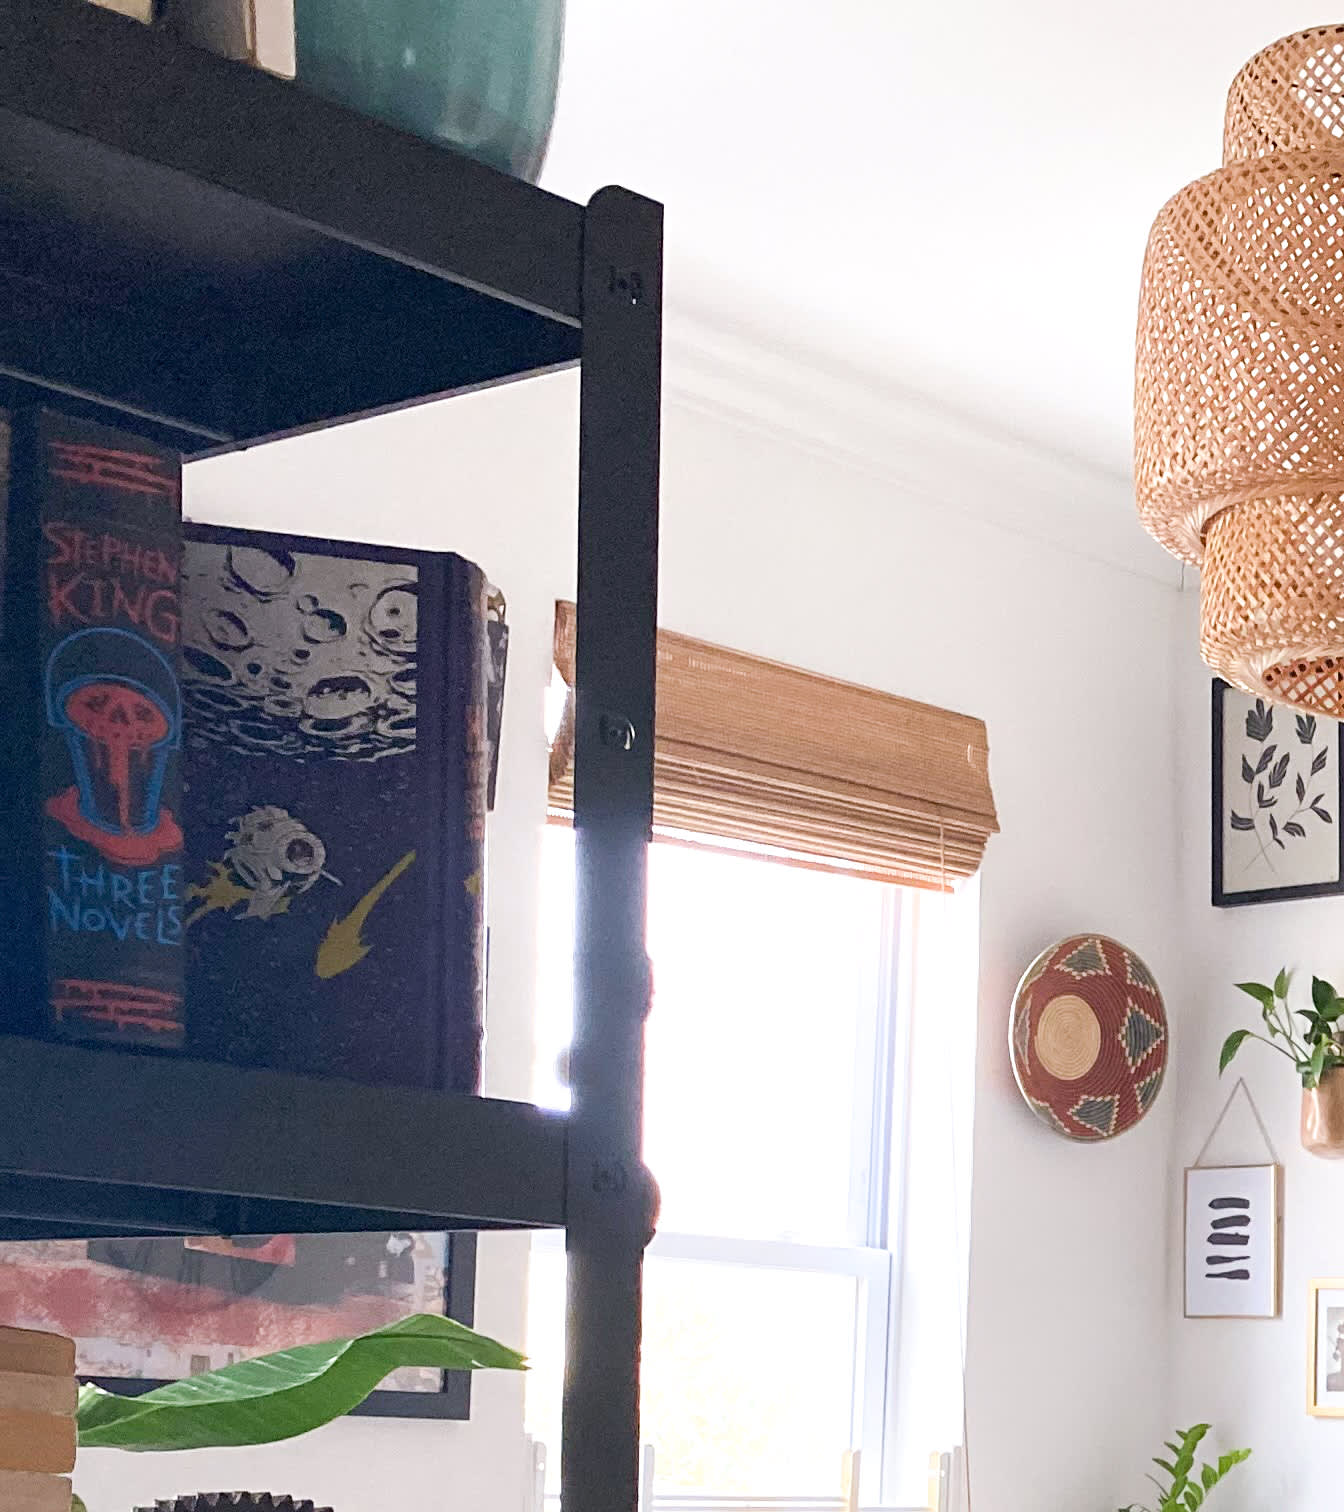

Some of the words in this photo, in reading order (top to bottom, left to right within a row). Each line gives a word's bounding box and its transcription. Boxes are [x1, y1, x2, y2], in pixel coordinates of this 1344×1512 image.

[43, 521, 178, 584] STEPHEN
[47, 574, 179, 644] KING
[49, 849, 179, 906] THREE
[48, 889, 183, 945] NOVELS
